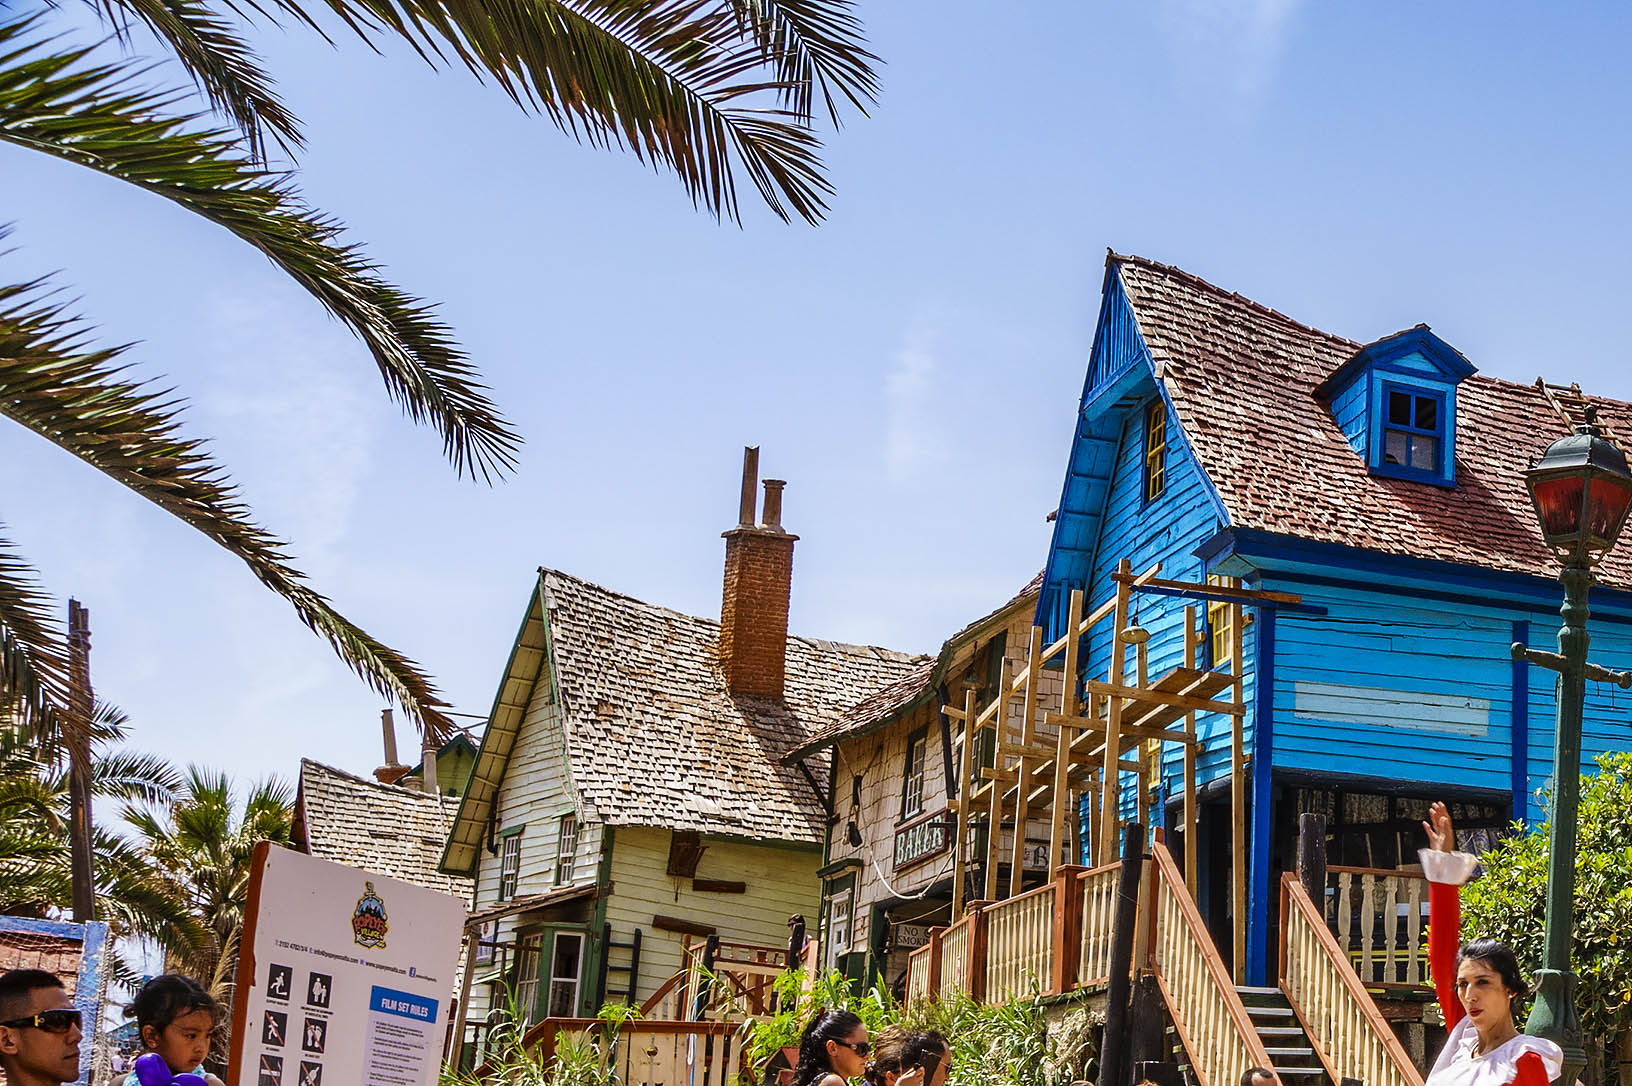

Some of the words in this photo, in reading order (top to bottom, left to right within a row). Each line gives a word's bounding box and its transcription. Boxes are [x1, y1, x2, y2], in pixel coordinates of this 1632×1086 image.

[896, 815, 943, 866] BAKER
[904, 927, 918, 937] NO
[897, 936, 929, 945] SMOKI
[381, 998, 398, 1011] FILM
[398, 1001, 410, 1013] SET
[410, 1004, 429, 1018] RULES
